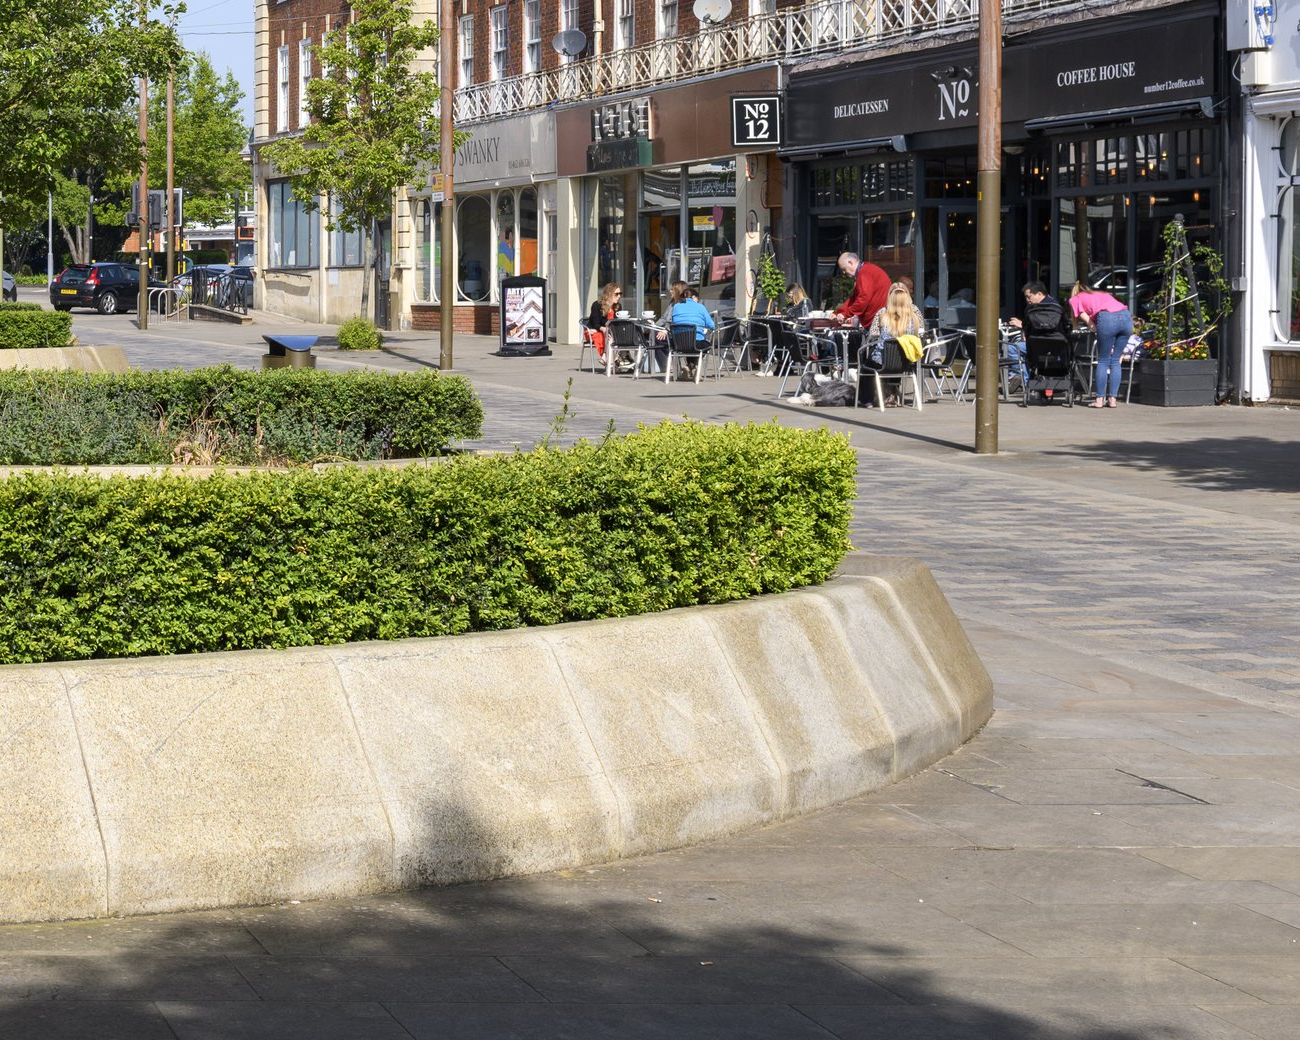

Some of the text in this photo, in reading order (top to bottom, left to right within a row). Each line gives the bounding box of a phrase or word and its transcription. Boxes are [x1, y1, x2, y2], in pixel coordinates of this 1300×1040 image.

[1056, 61, 1136, 87] COFFEE HOUSE
[1143, 75, 1205, 94] number12coffee.co.uk
[834, 98, 889, 119] DELICATESSEN
[745, 119, 770, 139] 12
[458, 136, 500, 167] SWANKY
